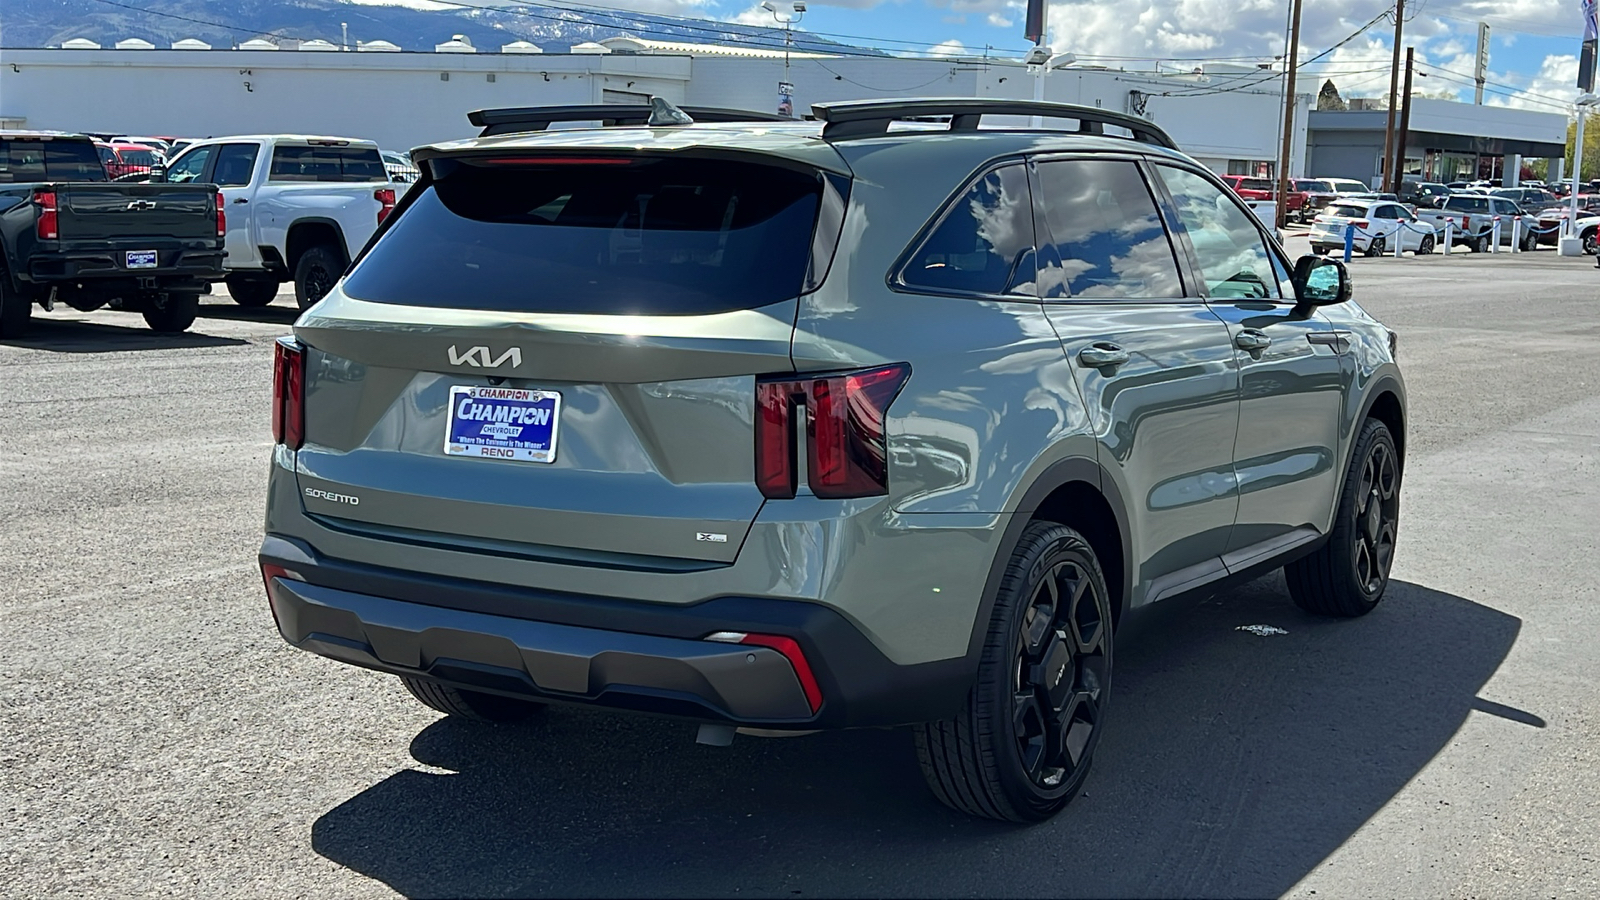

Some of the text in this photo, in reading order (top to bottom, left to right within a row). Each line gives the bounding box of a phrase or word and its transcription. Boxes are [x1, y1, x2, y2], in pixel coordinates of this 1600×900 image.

[447, 344, 522, 368] KIA
[479, 388, 530, 400] CHAMPION
[457, 398, 551, 426] CHAMPION
[483, 426, 519, 435] CHEVROLET
[481, 447, 515, 458] RENO
[305, 487, 359, 505] SORENTO
